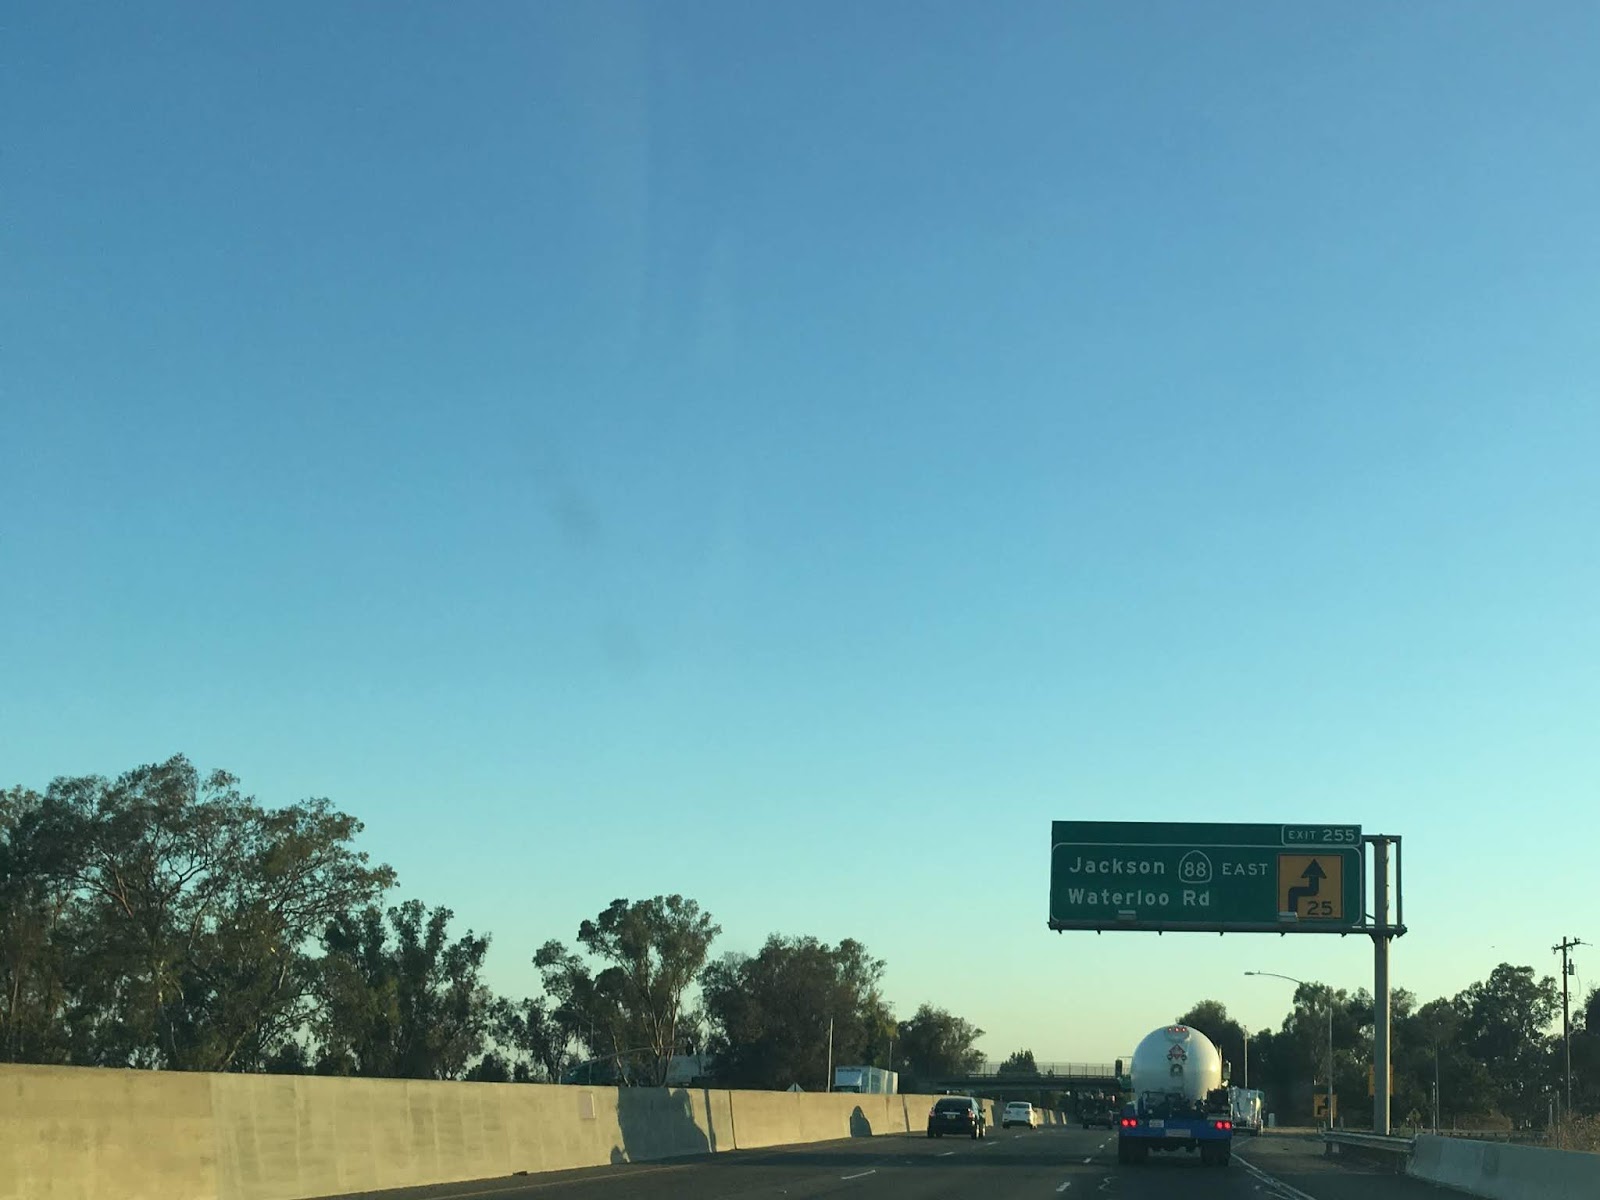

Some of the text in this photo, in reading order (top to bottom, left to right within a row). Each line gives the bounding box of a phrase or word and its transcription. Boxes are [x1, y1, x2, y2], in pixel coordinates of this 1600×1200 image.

[1288, 829, 1355, 842] EXIT 255
[1069, 856, 1268, 877] Jackson 88 EAST
[1068, 888, 1210, 907] Waterloo Rd
[1307, 901, 1333, 916] 25
